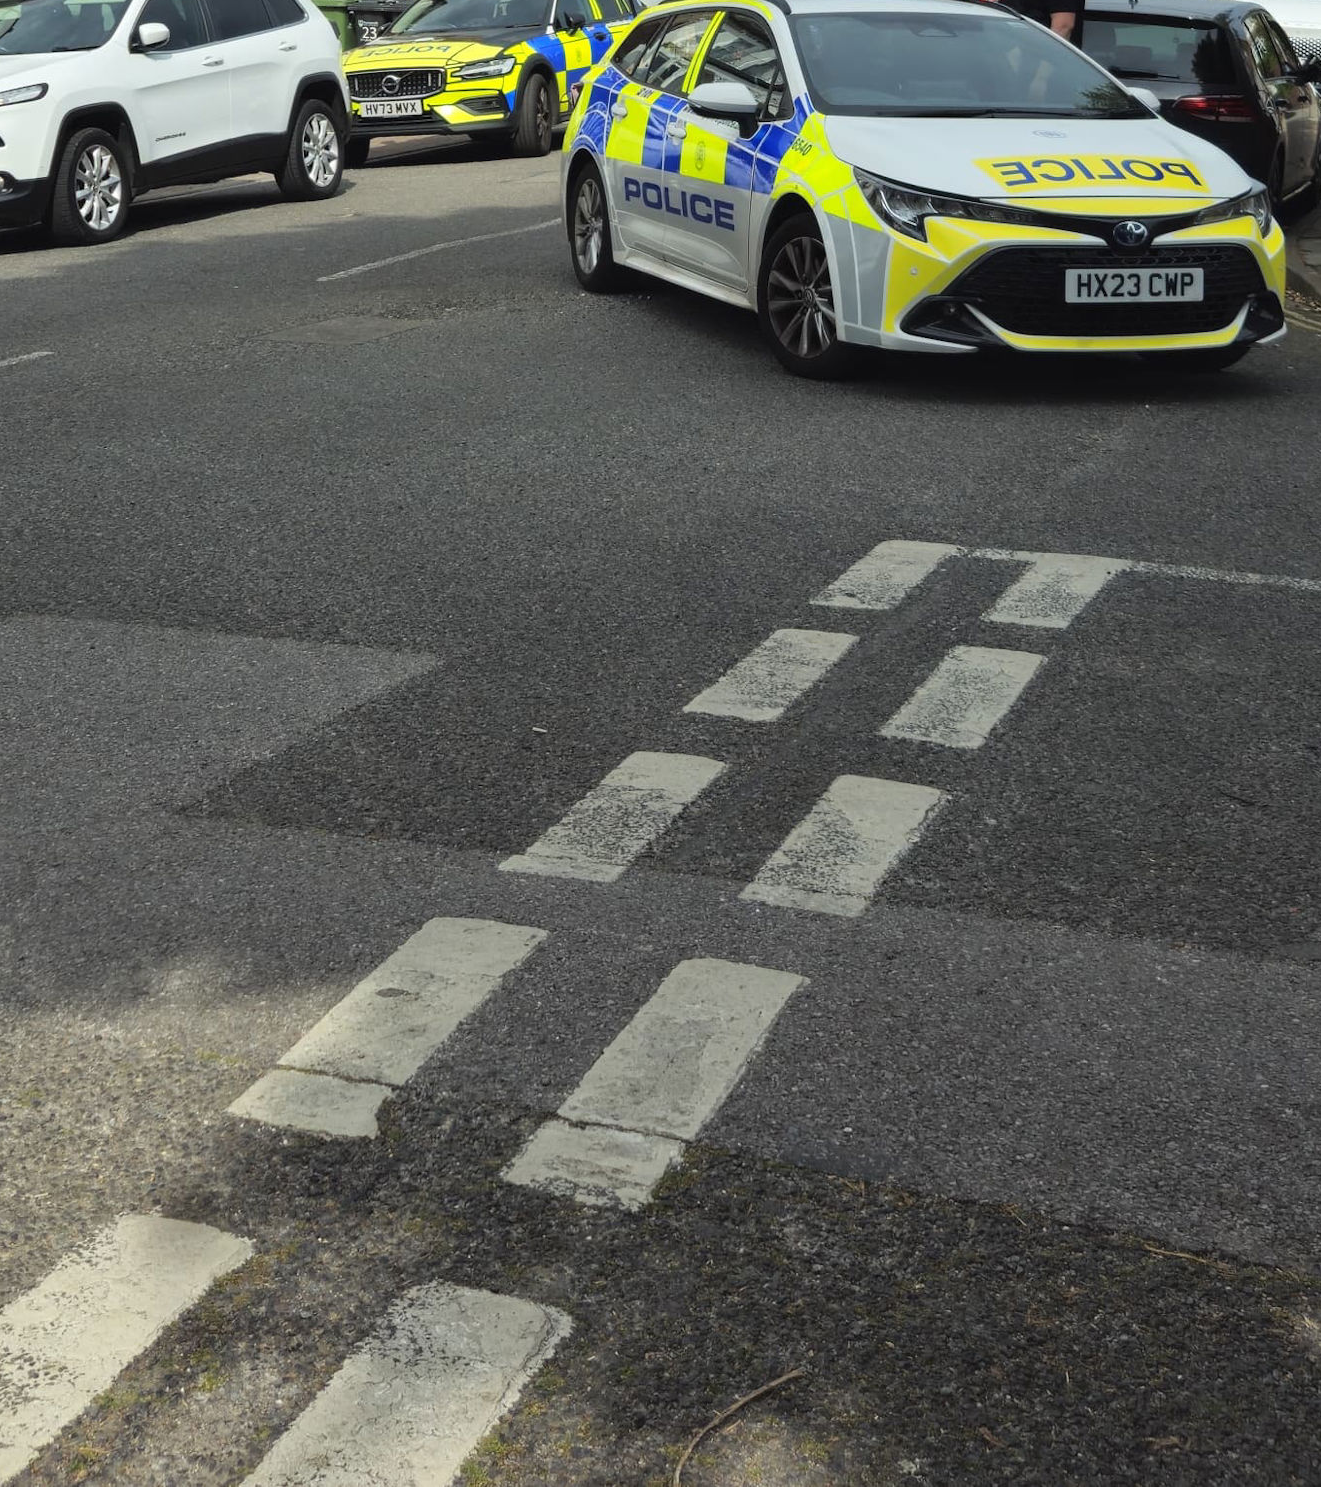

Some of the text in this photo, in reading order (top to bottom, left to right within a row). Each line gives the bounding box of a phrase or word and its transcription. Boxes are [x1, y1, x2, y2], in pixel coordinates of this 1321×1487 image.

[362, 26, 377, 39] 23
[365, 102, 418, 116] HV73 MVX
[624, 176, 735, 231] POLICE
[1077, 272, 1195, 298] HX23 CWP
